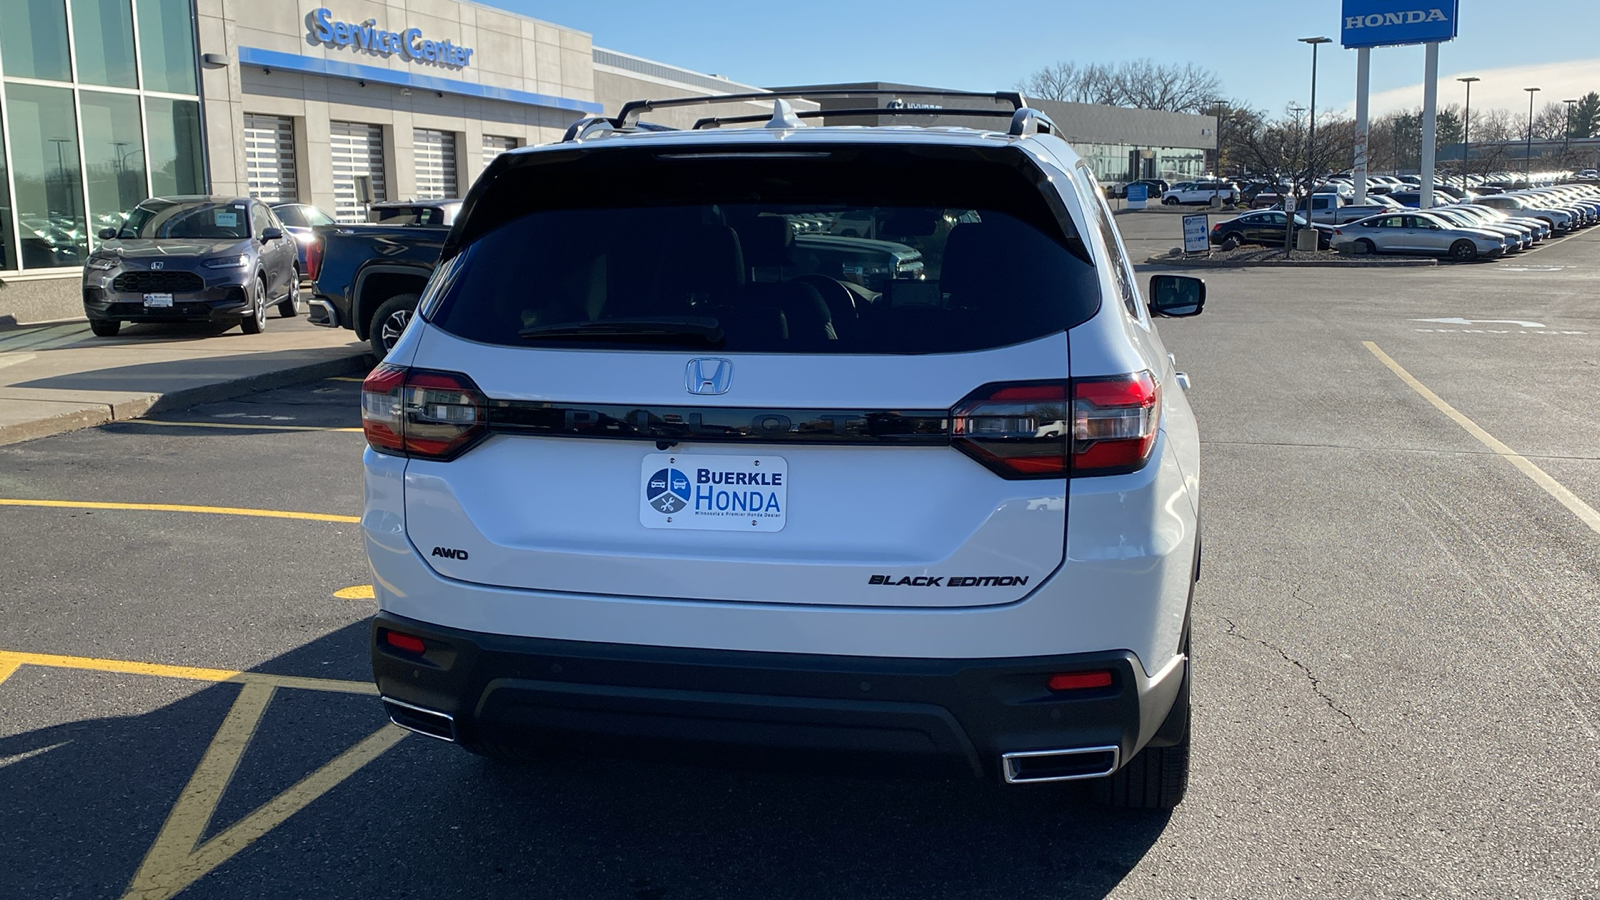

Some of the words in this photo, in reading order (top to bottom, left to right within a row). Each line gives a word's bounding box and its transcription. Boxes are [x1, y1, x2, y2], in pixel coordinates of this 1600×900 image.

[1344, 8, 1448, 29] HONDA
[314, 7, 400, 54] Service
[403, 27, 473, 67] Center
[565, 409, 861, 436] PILOT
[697, 468, 782, 486] BUERKLE
[695, 485, 781, 512] HONDA
[431, 546, 469, 561] AWD
[868, 574, 944, 587] BLACK
[946, 575, 1029, 587] EDITION
